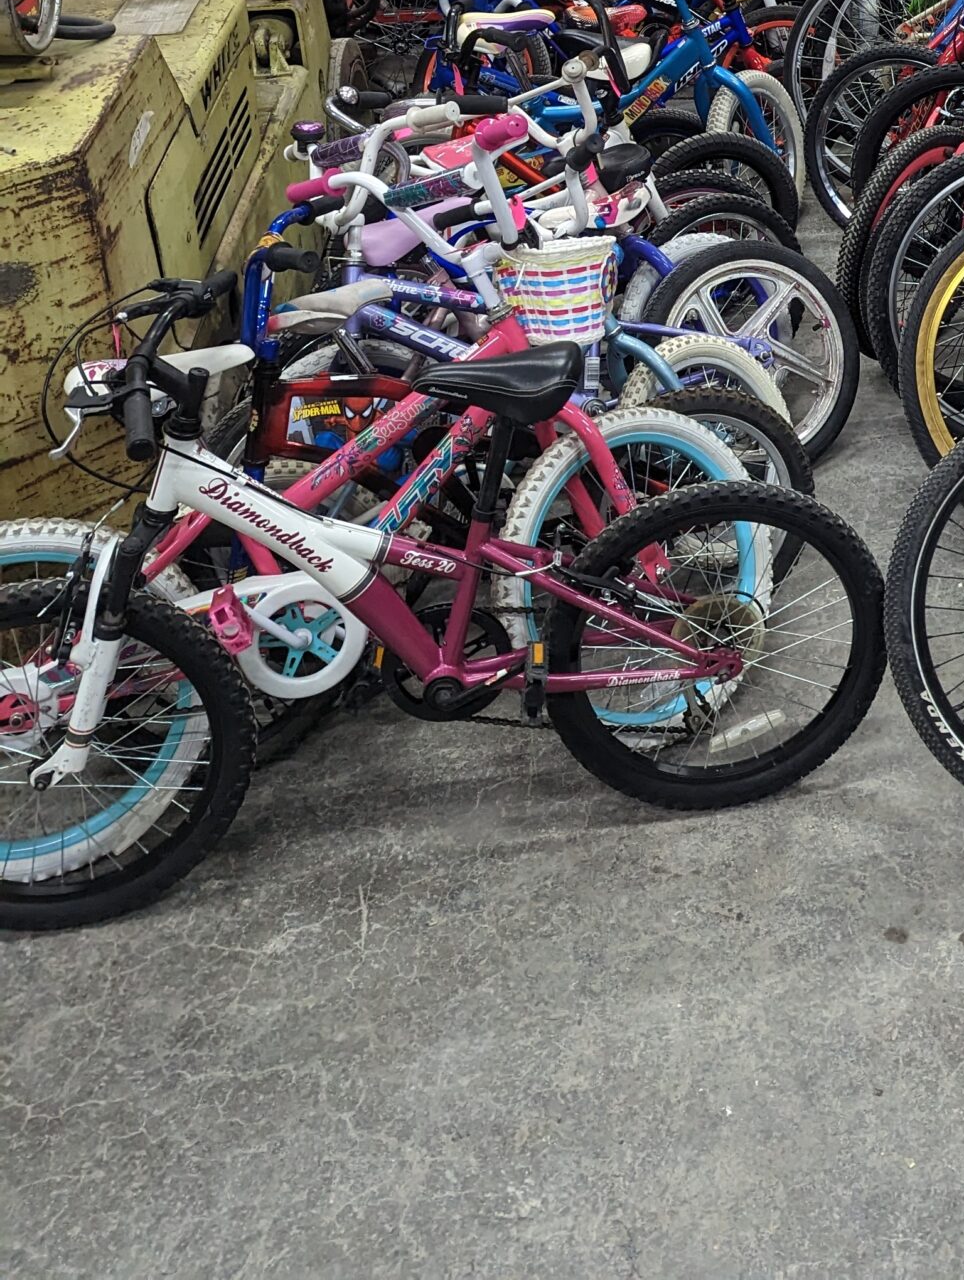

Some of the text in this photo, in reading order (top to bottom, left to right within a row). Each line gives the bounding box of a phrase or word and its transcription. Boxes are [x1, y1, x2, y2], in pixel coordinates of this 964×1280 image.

[293, 404, 341, 422] SPIDER-MAN
[198, 477, 334, 574] Diamondback
[400, 550, 456, 574] Tess 20
[606, 670, 681, 688] Diamondback
